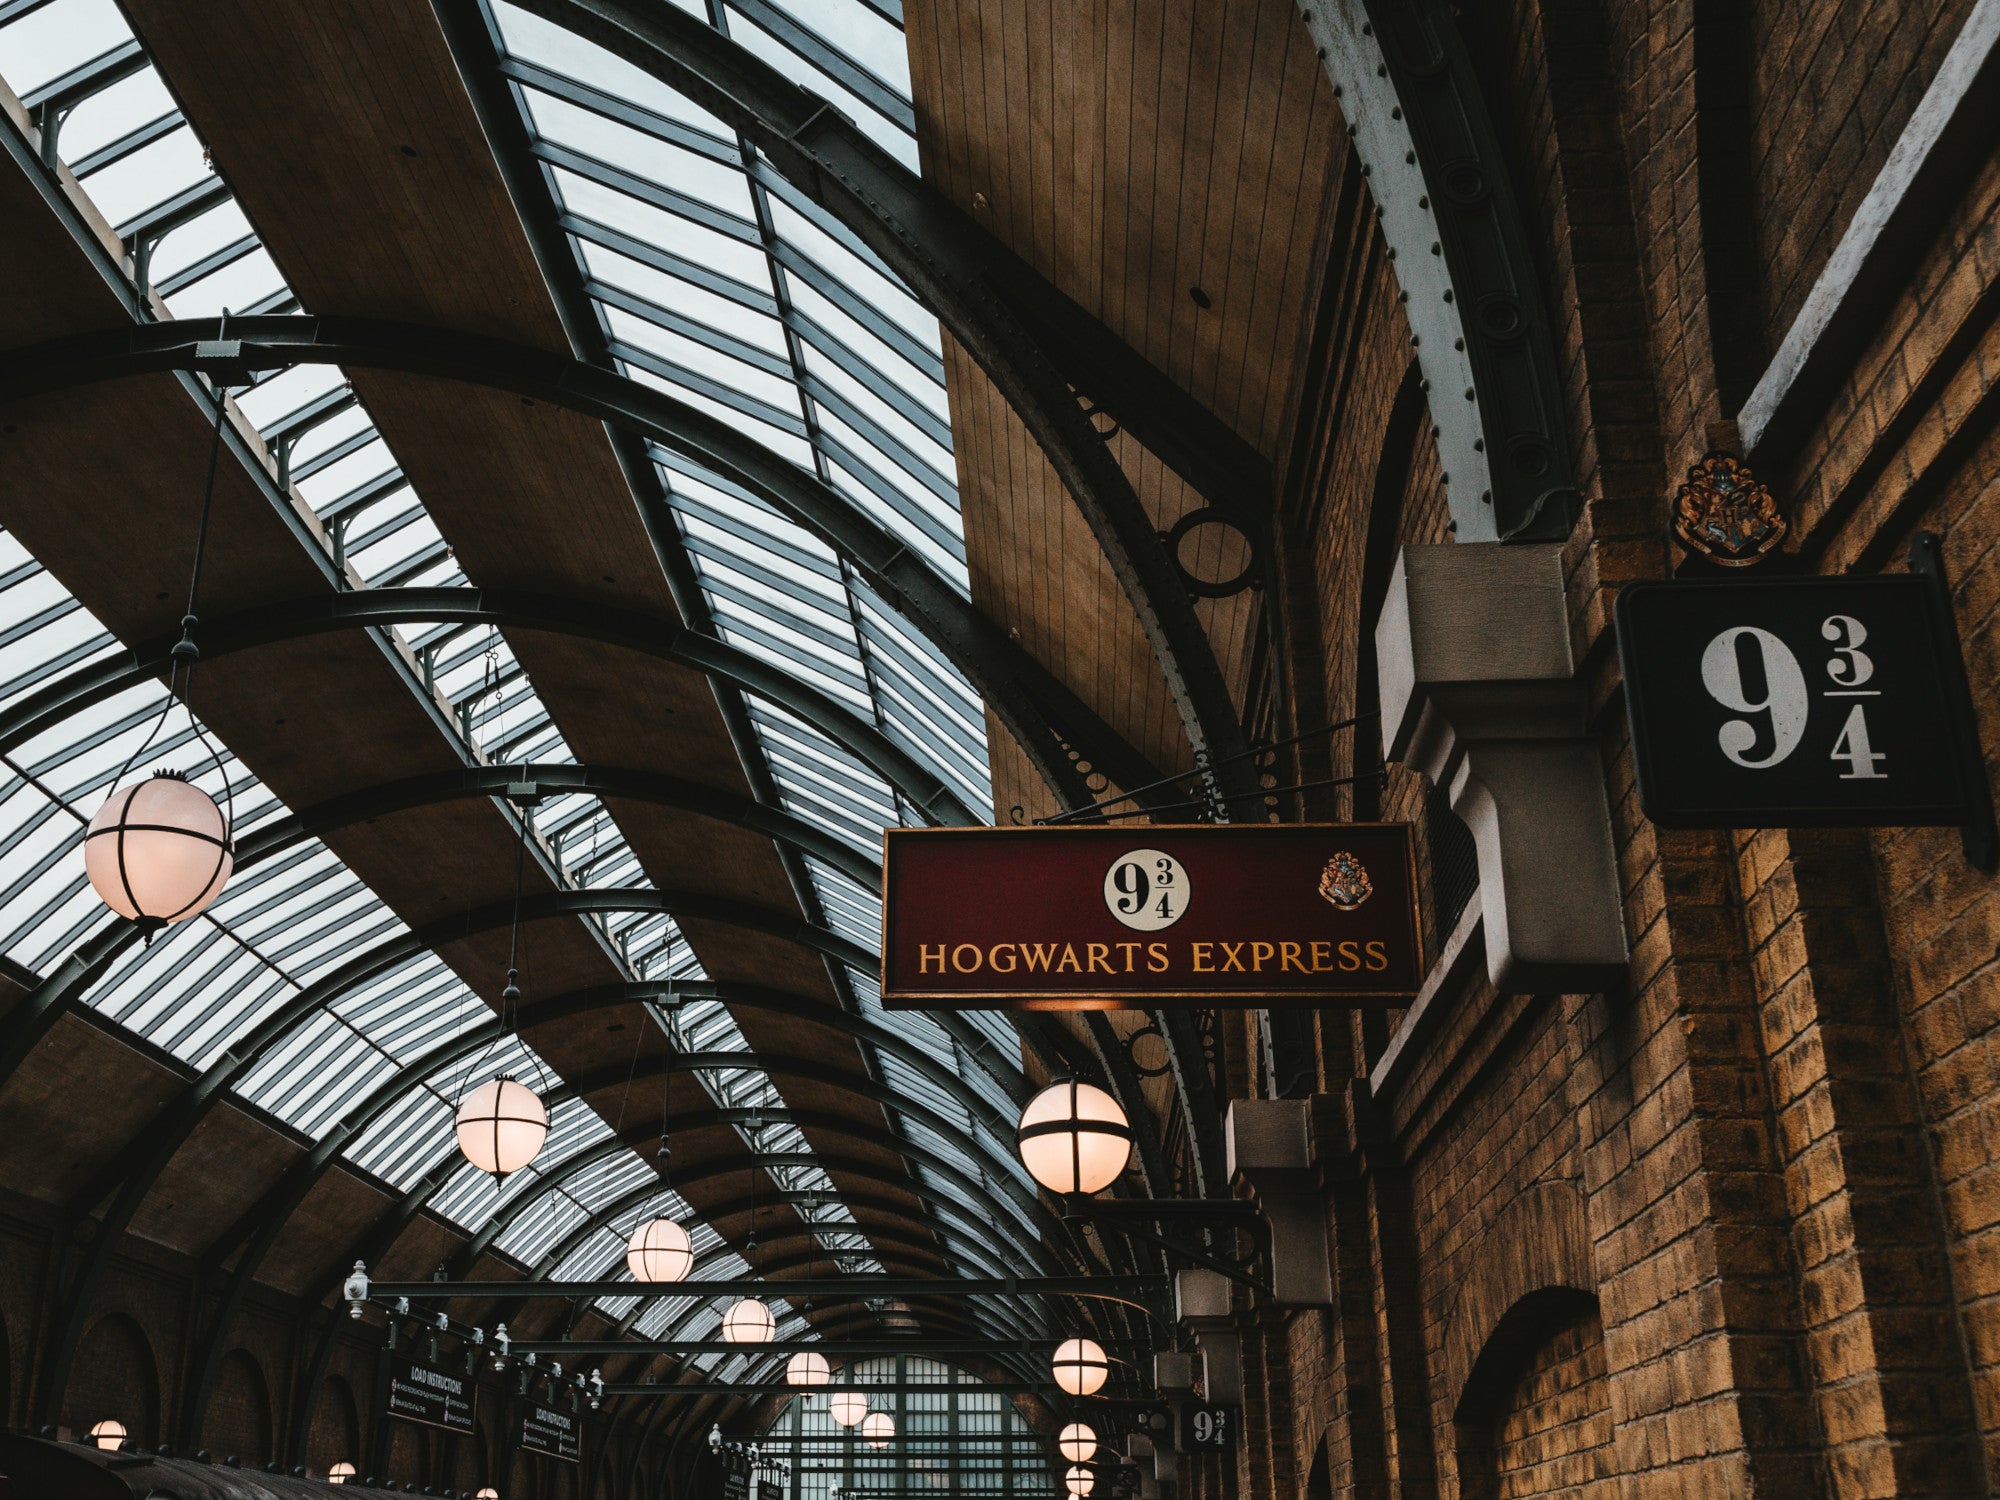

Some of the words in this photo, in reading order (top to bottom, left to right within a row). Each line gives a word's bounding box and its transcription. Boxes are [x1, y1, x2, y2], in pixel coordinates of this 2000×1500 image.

[918, 942, 1170, 975] HOGWARTS
[1193, 941, 1389, 975] EXPRESS
[411, 1365, 427, 1384] LOAD
[427, 1371, 462, 1395] INSTRUCTIONS
